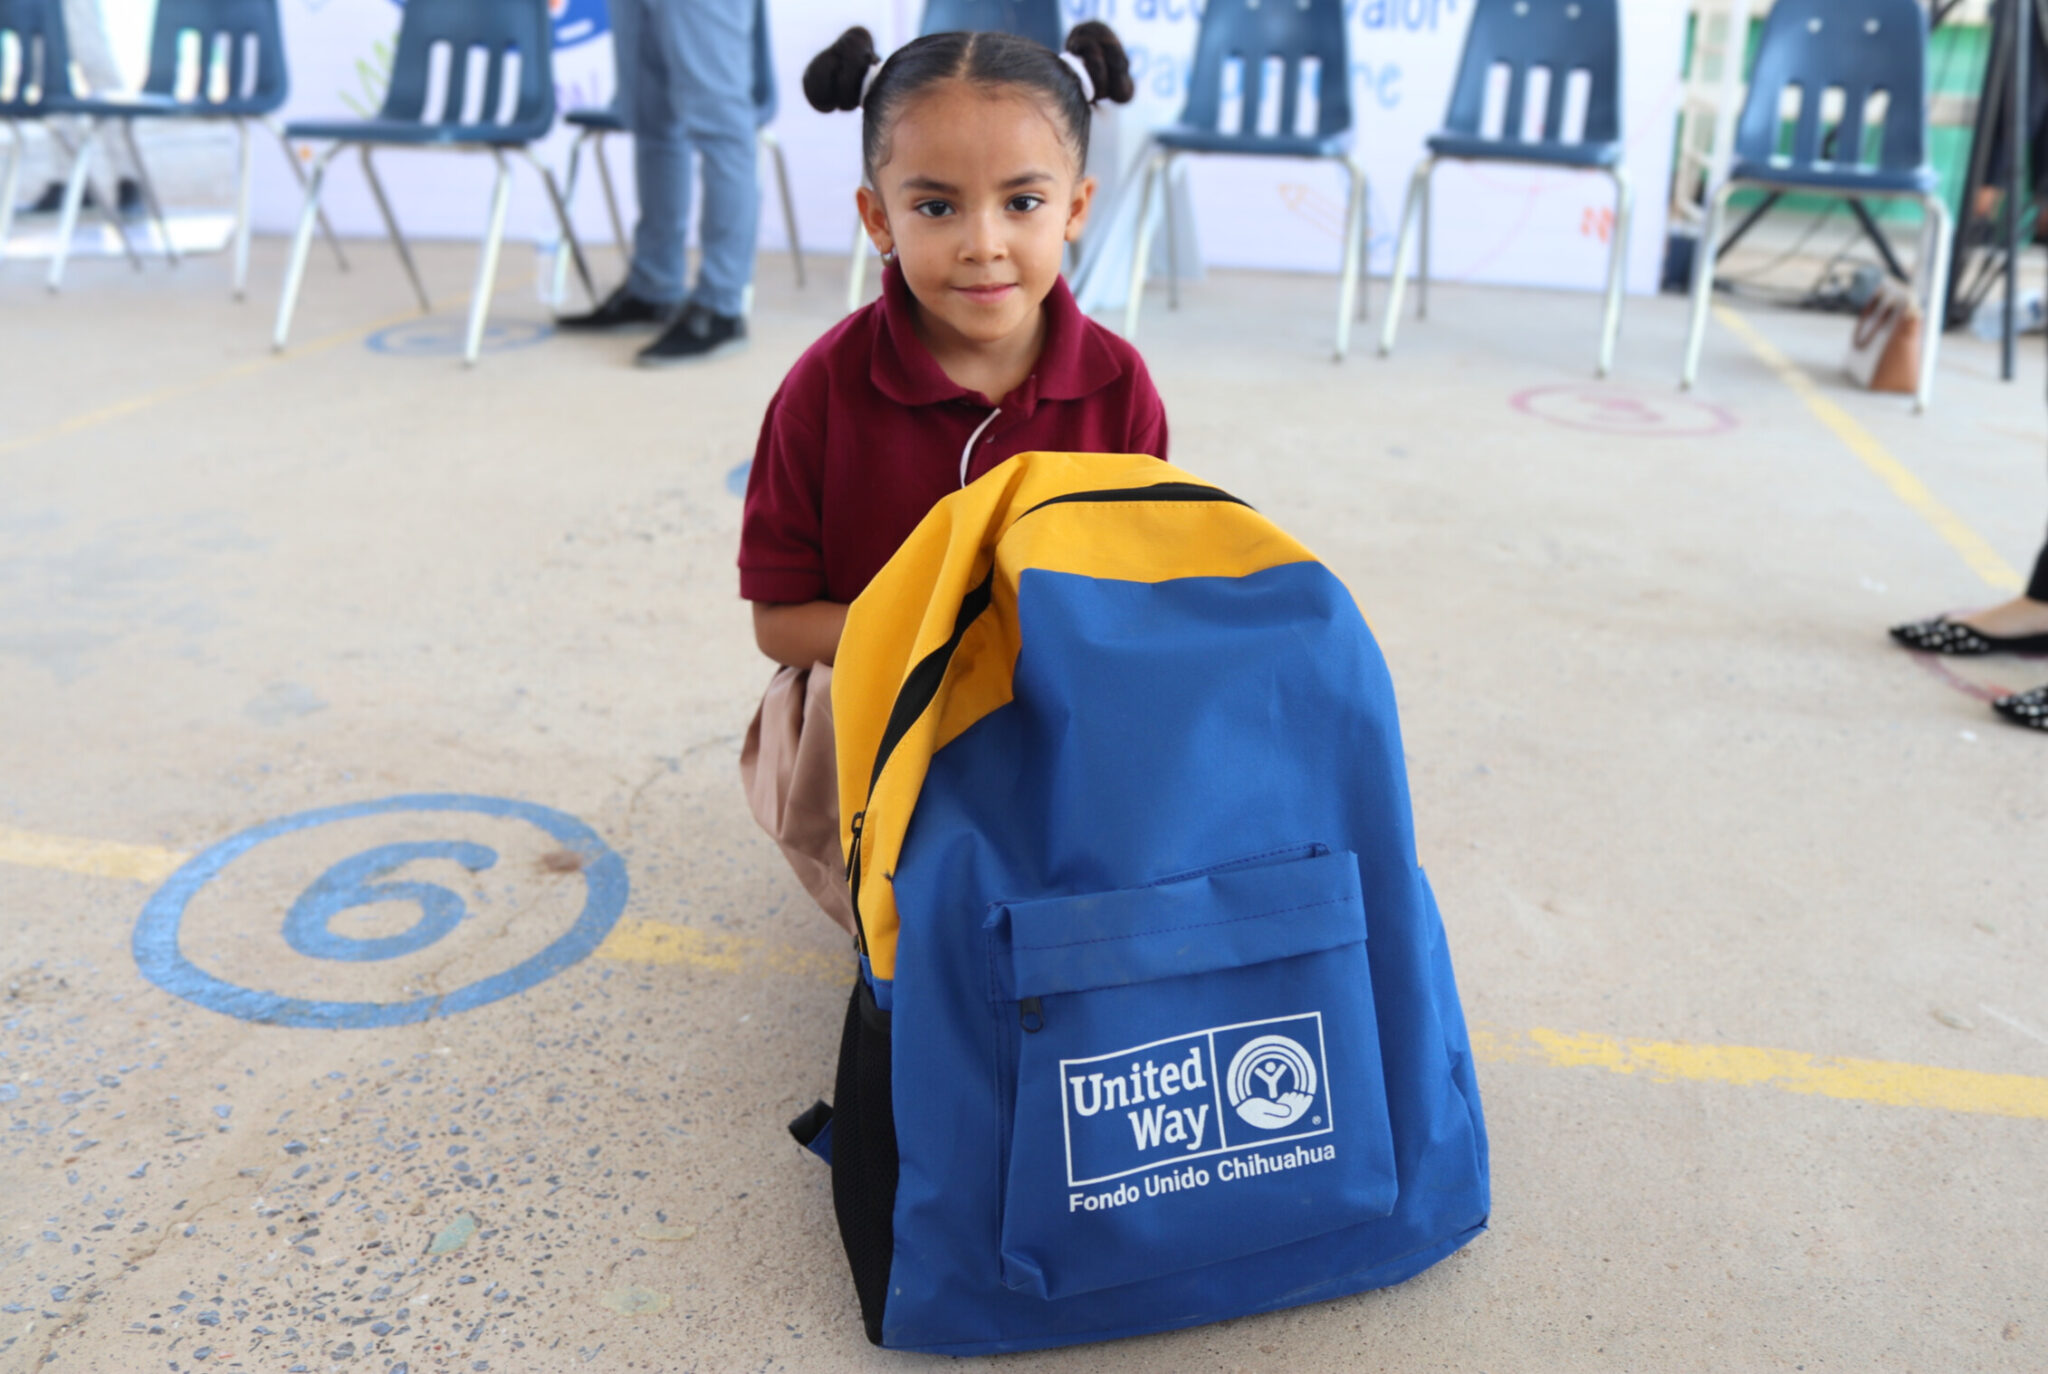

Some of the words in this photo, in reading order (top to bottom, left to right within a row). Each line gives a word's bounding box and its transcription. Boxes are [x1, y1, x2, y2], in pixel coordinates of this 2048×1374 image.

[282, 841, 498, 962] 6
[1069, 1046, 1207, 1117] United
[1127, 1103, 1209, 1151] Way
[1069, 1183, 1140, 1213] Fondo
[1144, 1166, 1210, 1197] Unido
[1217, 1145, 1336, 1182] Chihuahua
